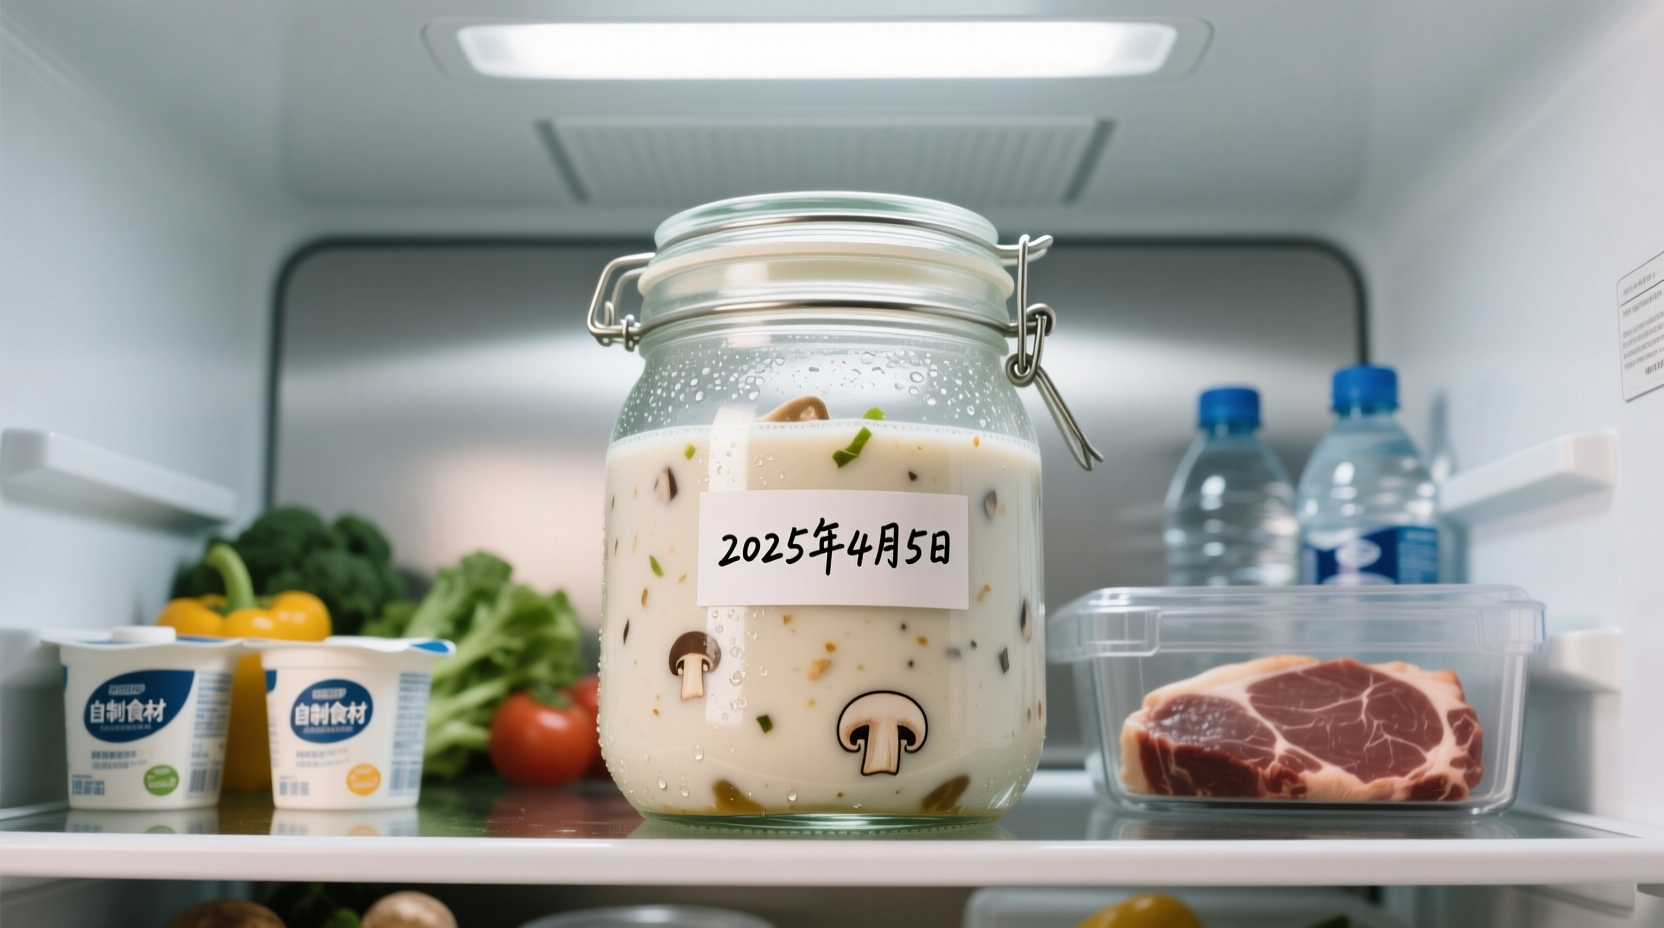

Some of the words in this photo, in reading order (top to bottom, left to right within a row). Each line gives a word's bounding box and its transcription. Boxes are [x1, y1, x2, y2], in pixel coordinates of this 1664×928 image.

[718, 517, 951, 576] 2025年4月5日
[90, 698, 166, 724] 自制食材
[295, 701, 367, 725] 自制食材
